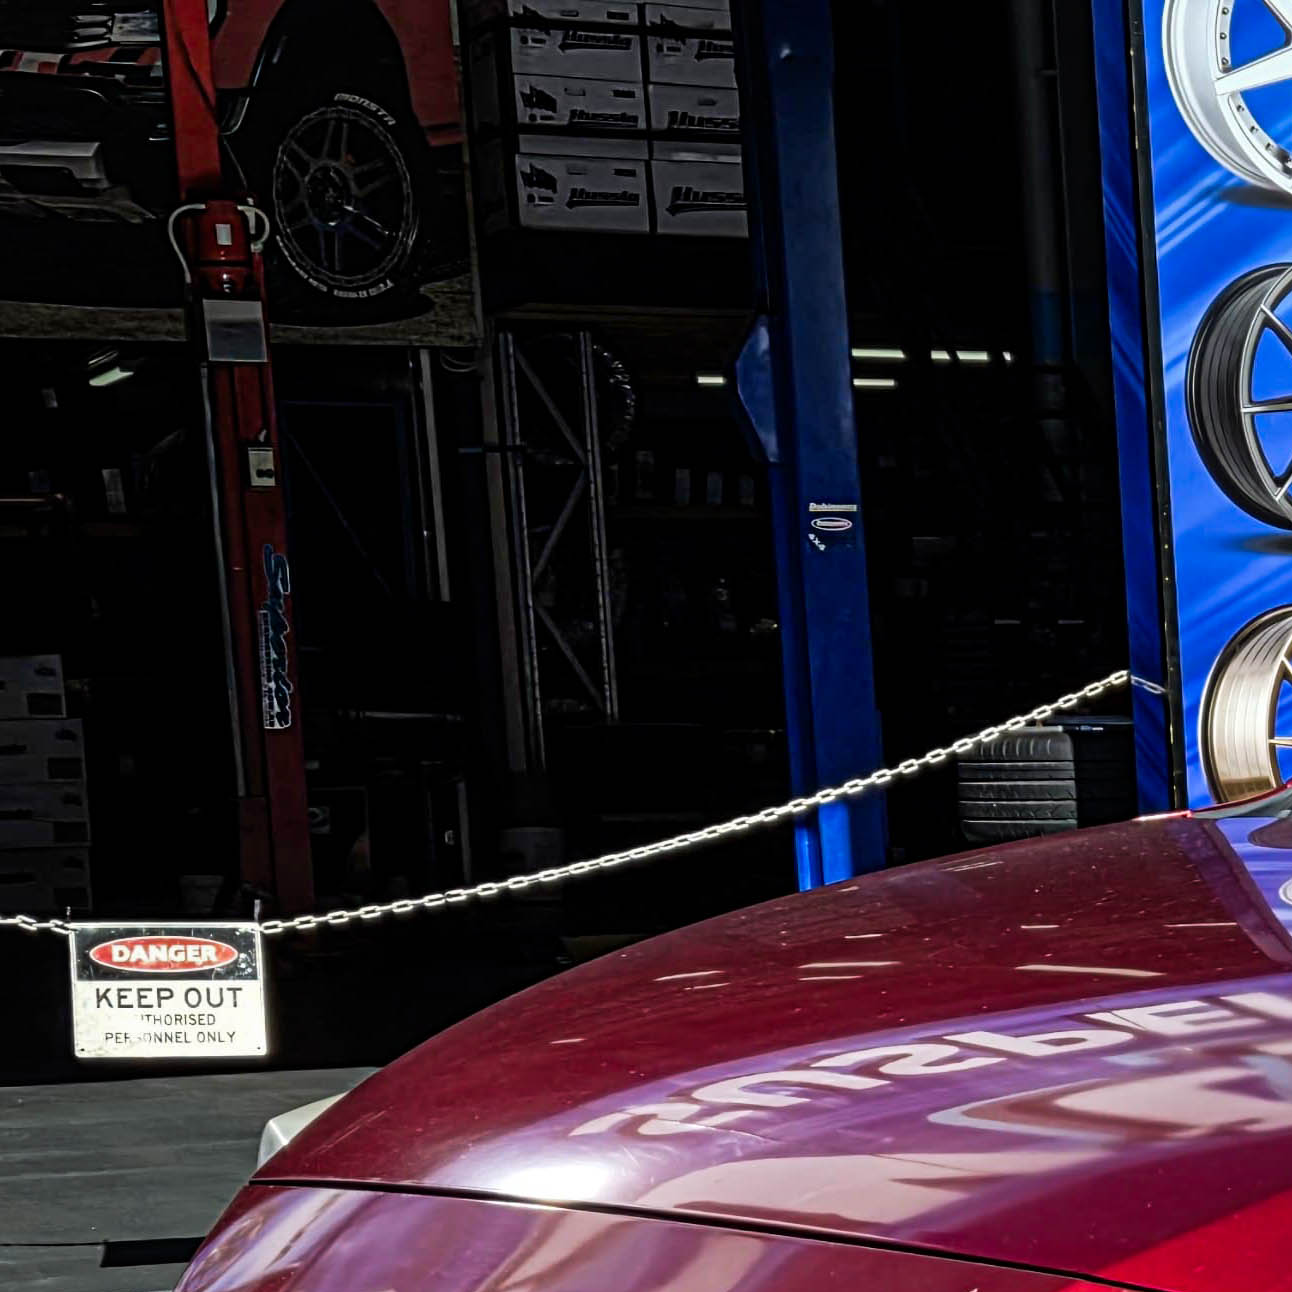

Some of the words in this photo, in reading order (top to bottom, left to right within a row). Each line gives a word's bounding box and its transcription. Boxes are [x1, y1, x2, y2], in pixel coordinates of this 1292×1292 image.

[111, 944, 218, 963] DANGER
[96, 987, 174, 1009] KEEP
[184, 987, 243, 1009] OUT
[139, 1013, 216, 1027] THORISED
[197, 1031, 237, 1044] ONLY
